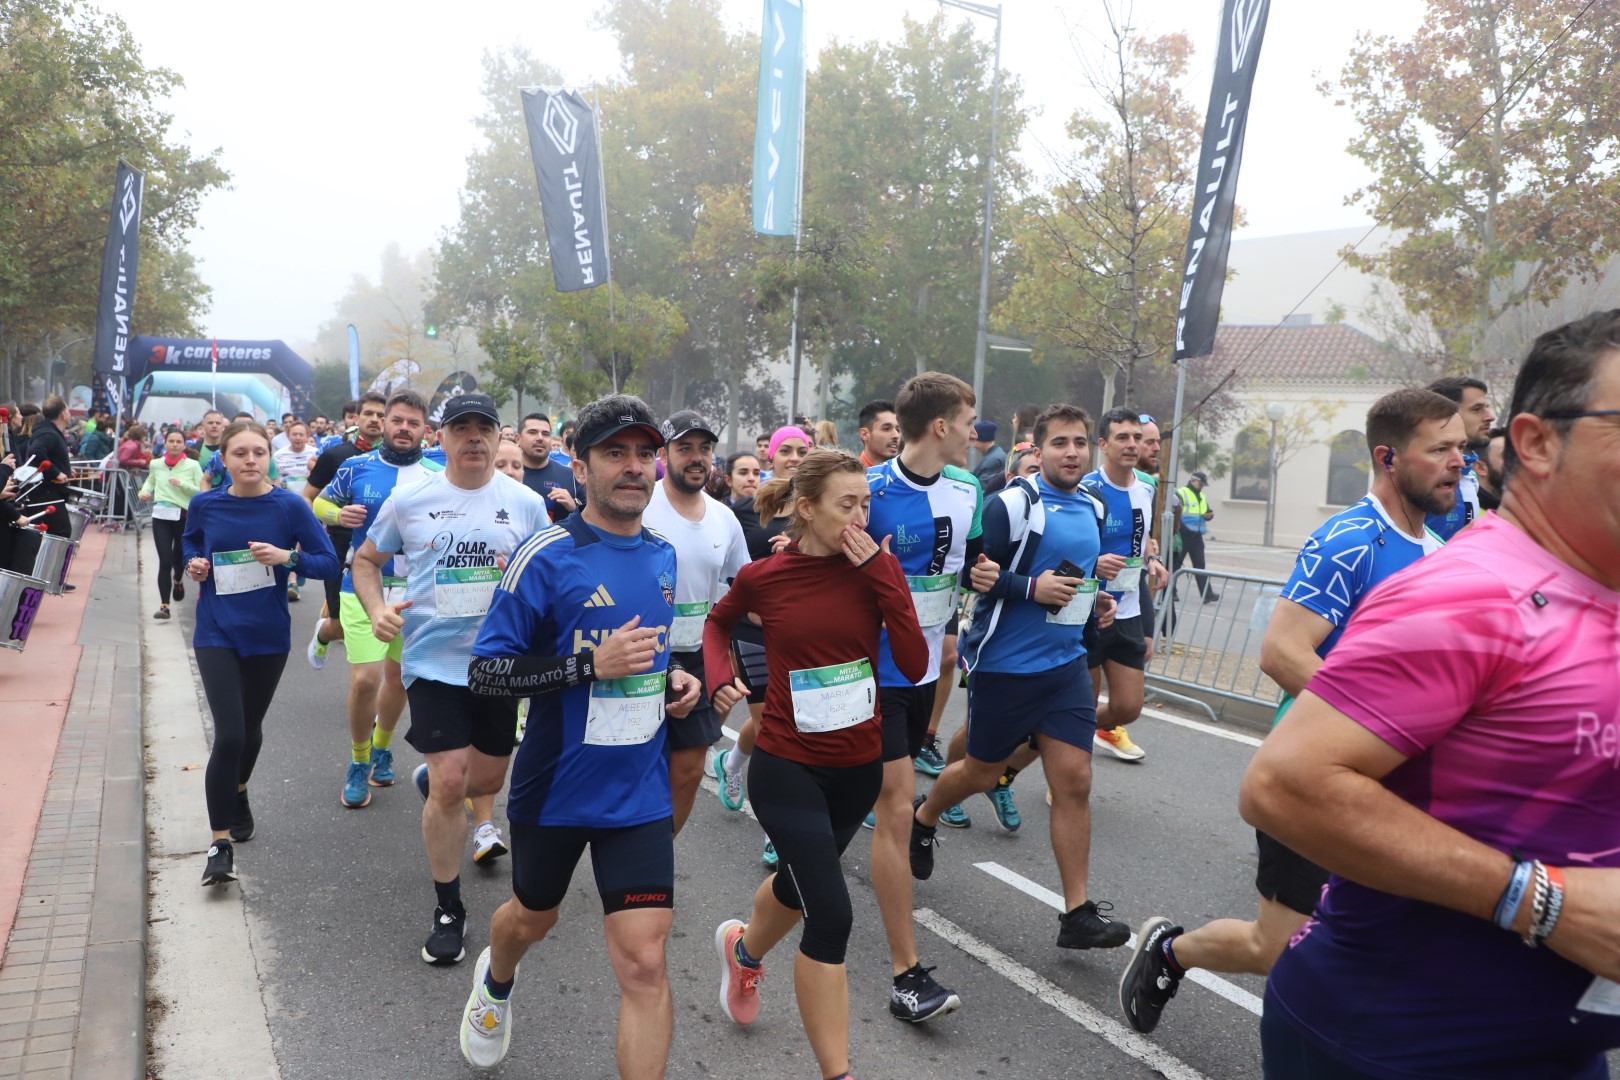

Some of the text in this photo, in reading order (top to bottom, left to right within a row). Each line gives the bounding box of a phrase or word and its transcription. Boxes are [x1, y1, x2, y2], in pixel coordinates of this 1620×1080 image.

[1176, 92, 1238, 352] RENAULT
[184, 346, 272, 360] careteres
[446, 554, 496, 568] DESTINO
[509, 666, 563, 688] MARATÓ
[839, 665, 859, 676] MITJA
[820, 689, 850, 701] MARIA
[617, 701, 651, 713] ALBERT
[829, 703, 847, 713] 622
[627, 717, 642, 726] 192
[1144, 925, 1166, 952] HOKA
